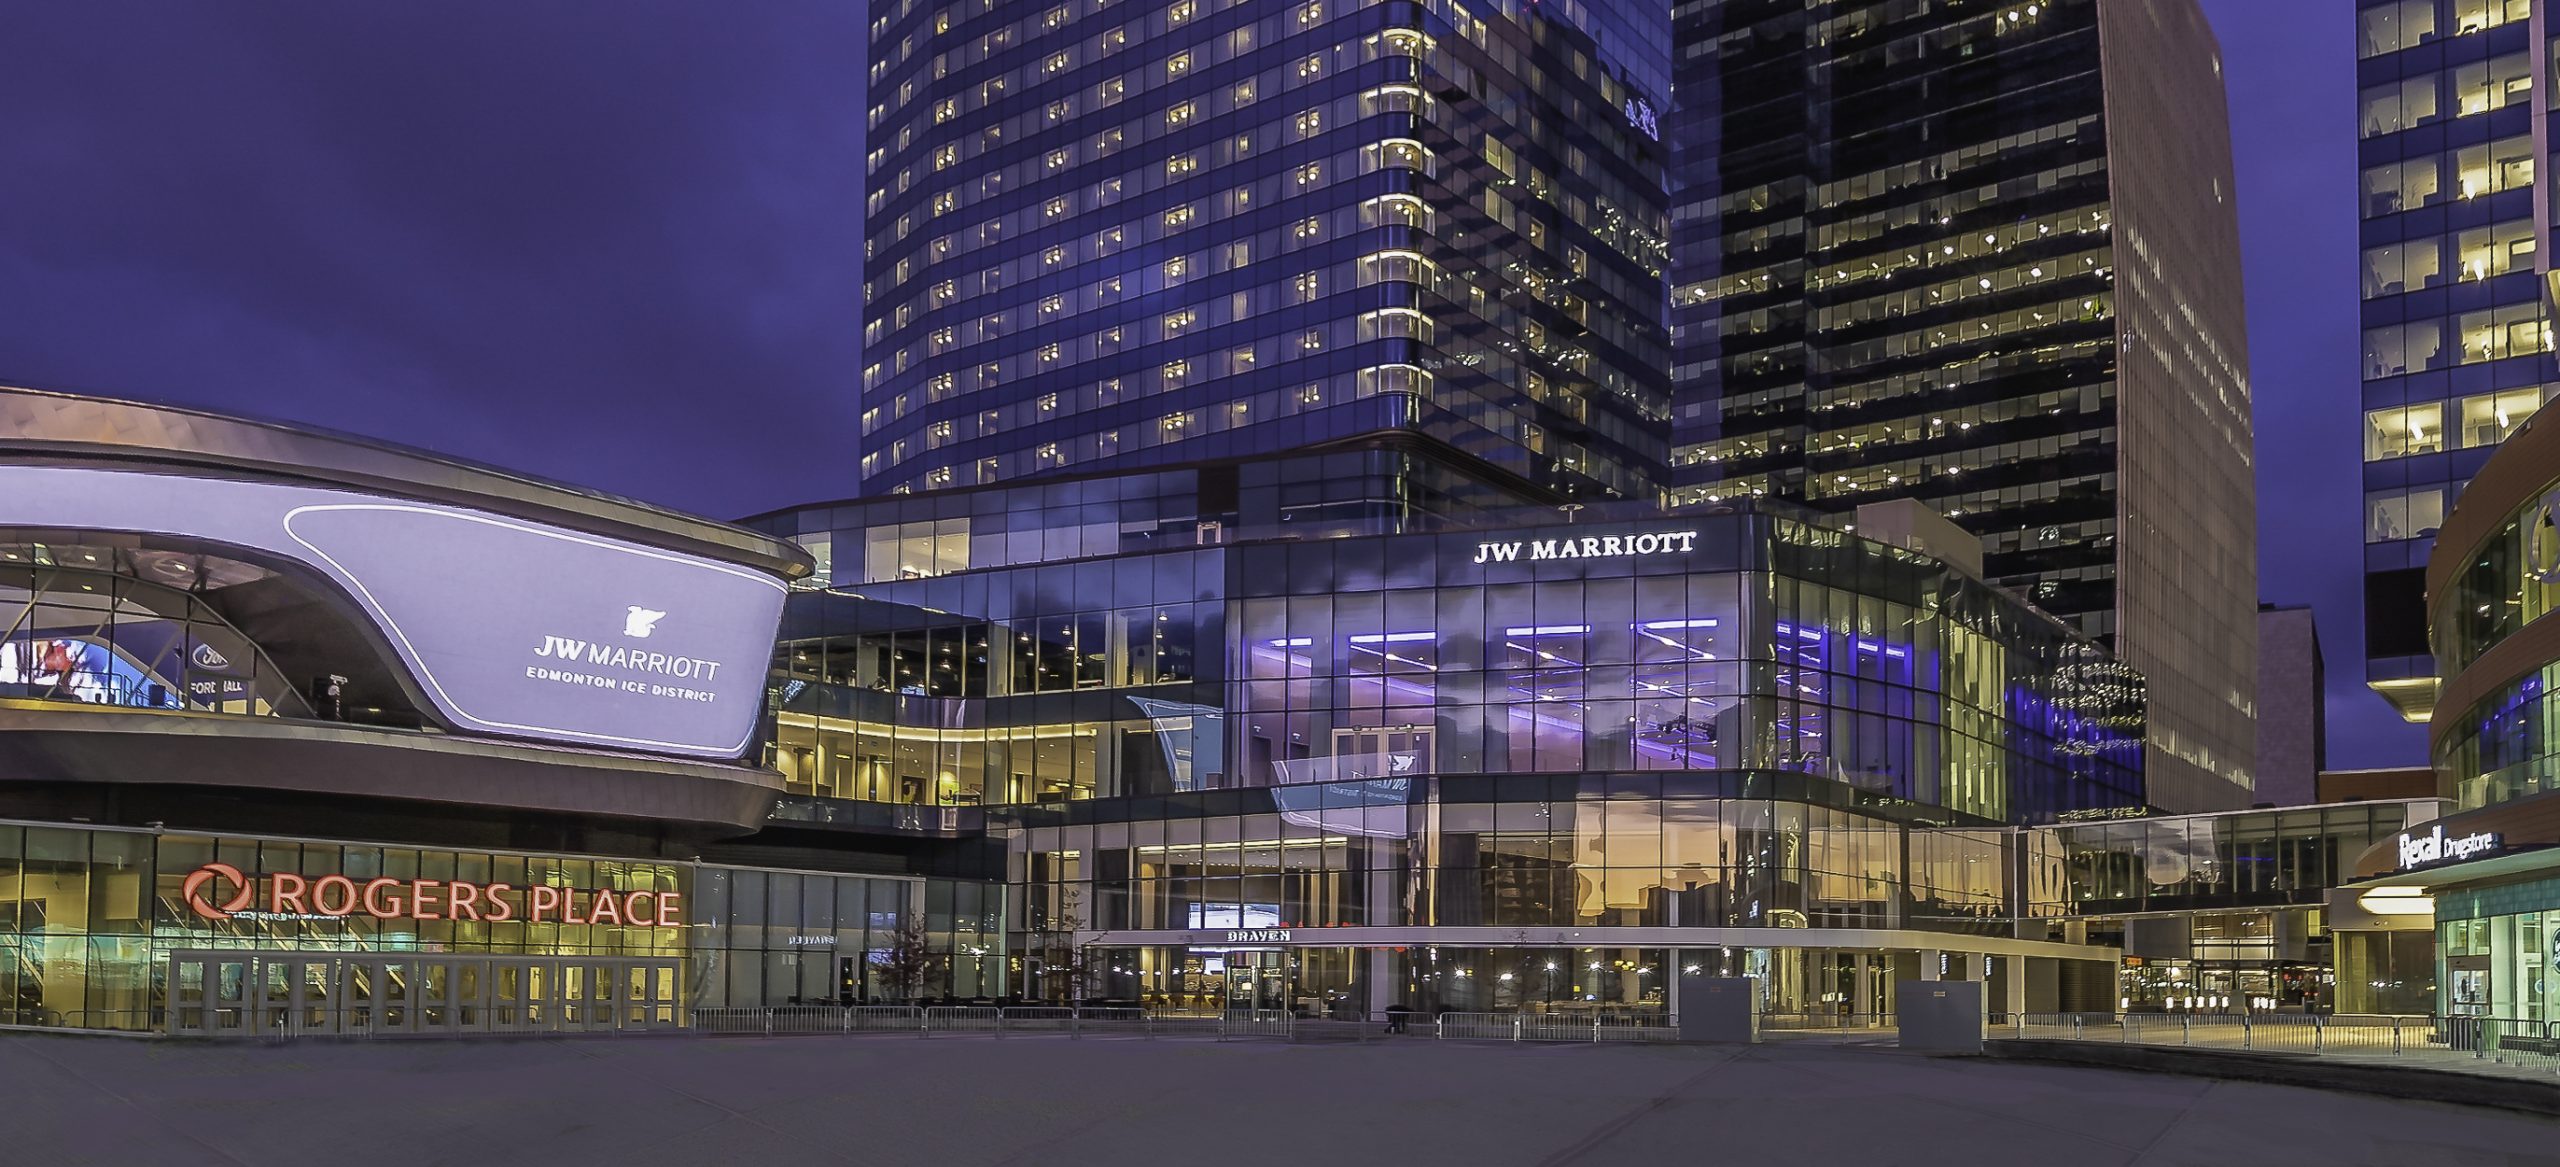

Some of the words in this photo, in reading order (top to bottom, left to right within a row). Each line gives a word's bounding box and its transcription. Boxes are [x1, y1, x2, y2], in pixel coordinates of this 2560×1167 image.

[1473, 542, 1522, 564] JW
[1530, 531, 1697, 560] MARRIOTT
[533, 635, 587, 661] JW
[587, 643, 721, 681] MARRIOTT
[526, 666, 617, 689] EDMONTON
[621, 680, 648, 694] ICE
[651, 684, 716, 703] DISTRICT
[2399, 825, 2442, 870] Rexall
[2443, 832, 2493, 860] Drugstore
[270, 873, 512, 922] ROGERS
[531, 886, 682, 927] PLACE
[1227, 930, 1291, 942] BRAVEN
